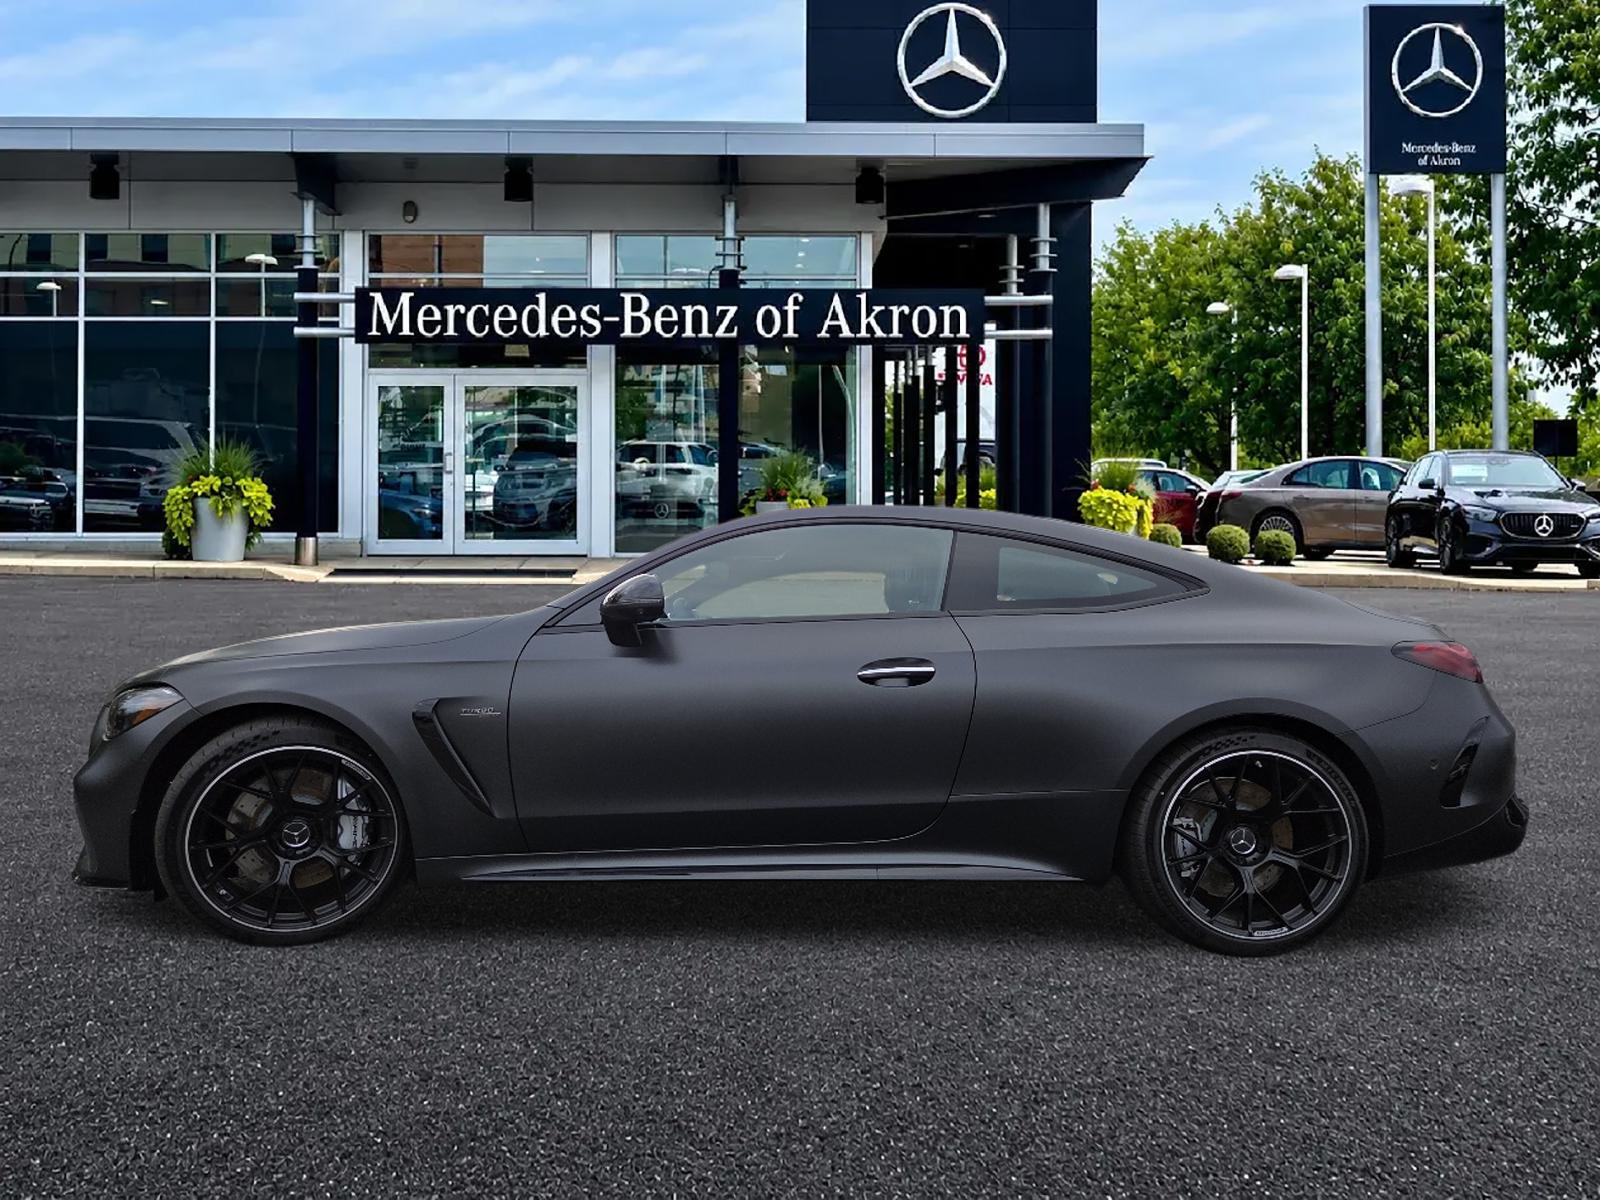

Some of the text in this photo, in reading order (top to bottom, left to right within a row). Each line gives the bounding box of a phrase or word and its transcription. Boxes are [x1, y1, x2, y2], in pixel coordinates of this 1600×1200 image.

[1401, 142, 1477, 153] Mercedes-Benz
[1417, 155, 1461, 166] of Akron
[367, 291, 971, 338] Mercedes-Benz of Akron
